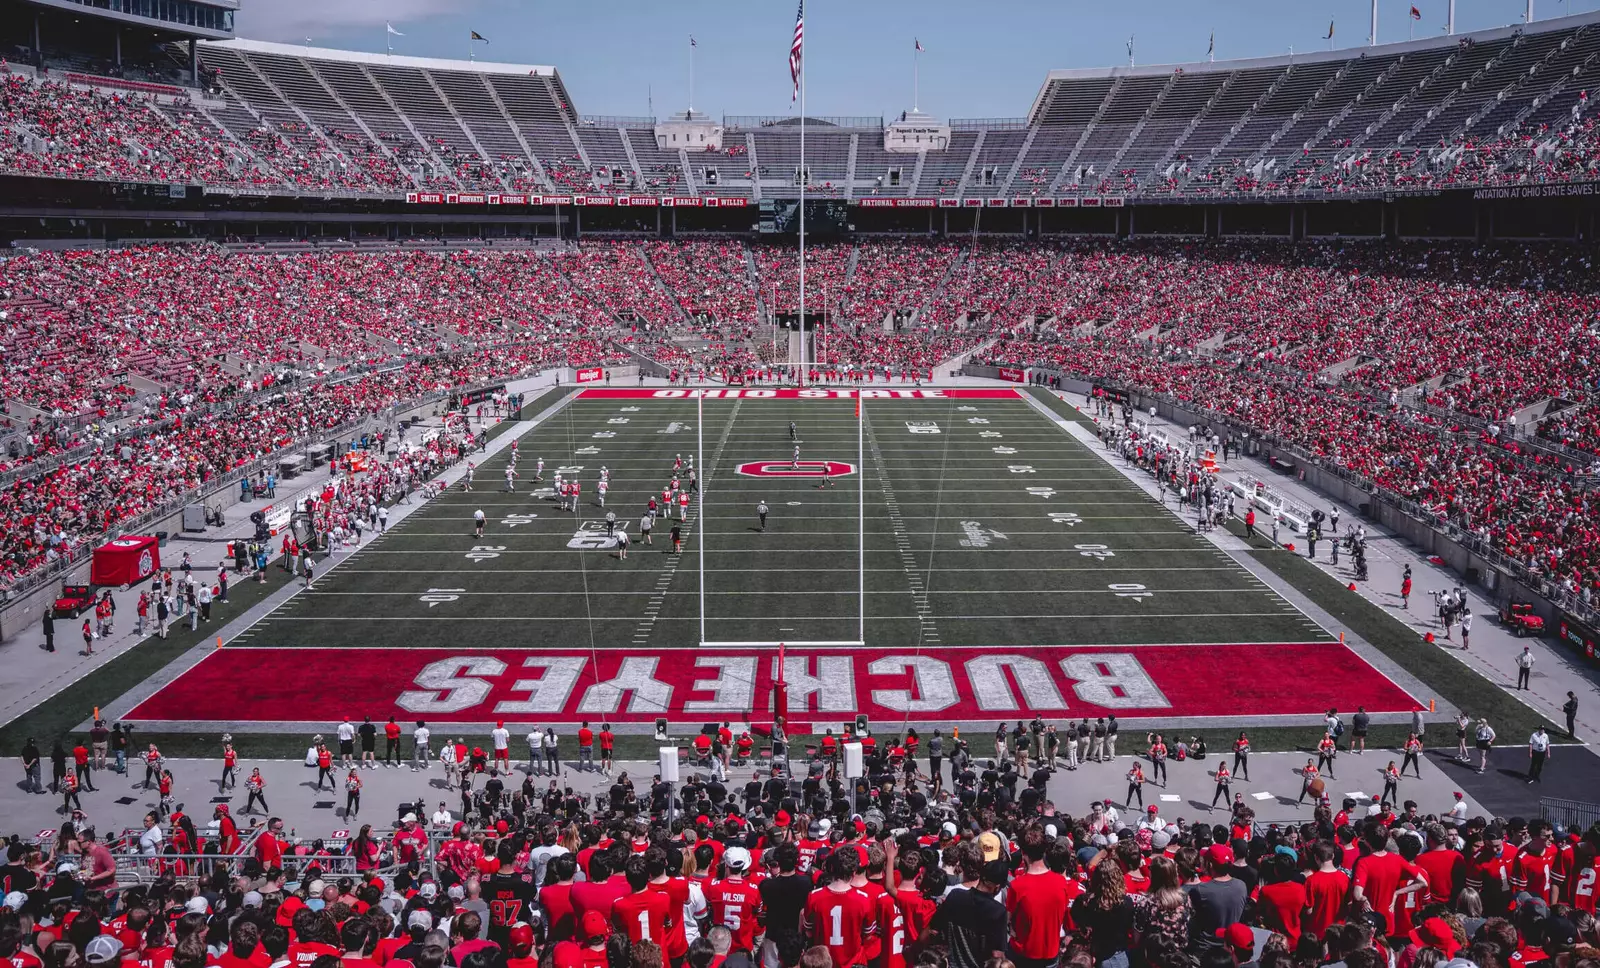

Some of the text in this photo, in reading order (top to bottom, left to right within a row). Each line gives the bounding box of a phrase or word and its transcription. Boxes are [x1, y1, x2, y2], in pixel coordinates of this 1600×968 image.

[420, 194, 440, 202] SMITH
[1473, 188, 1510, 200] ANTATION
[1510, 188, 1521, 198] AT
[1522, 186, 1540, 197] OHIO
[1542, 185, 1566, 196] STATE
[1566, 184, 1593, 196] SAVES
[502, 196, 524, 204] GEORGE
[580, 370, 599, 381] meijer
[652, 390, 948, 398] OHIO STATE
[464, 546, 506, 558] 20
[1074, 544, 1116, 556] 20
[419, 588, 466, 602] 10
[1108, 584, 1154, 596] 10
[1568, 630, 1584, 648] TOYOTA
[394, 652, 1173, 714] BUCKEYES
[1500, 865, 1510, 892] 1
[1544, 864, 1550, 892] 1
[1576, 868, 1596, 896] 2
[722, 892, 746, 902] WILSON
[490, 899, 522, 926] 97
[724, 904, 742, 930] 5
[638, 910, 652, 942] 1
[830, 905, 844, 946] 1
[296, 952, 318, 961] YOUNG
